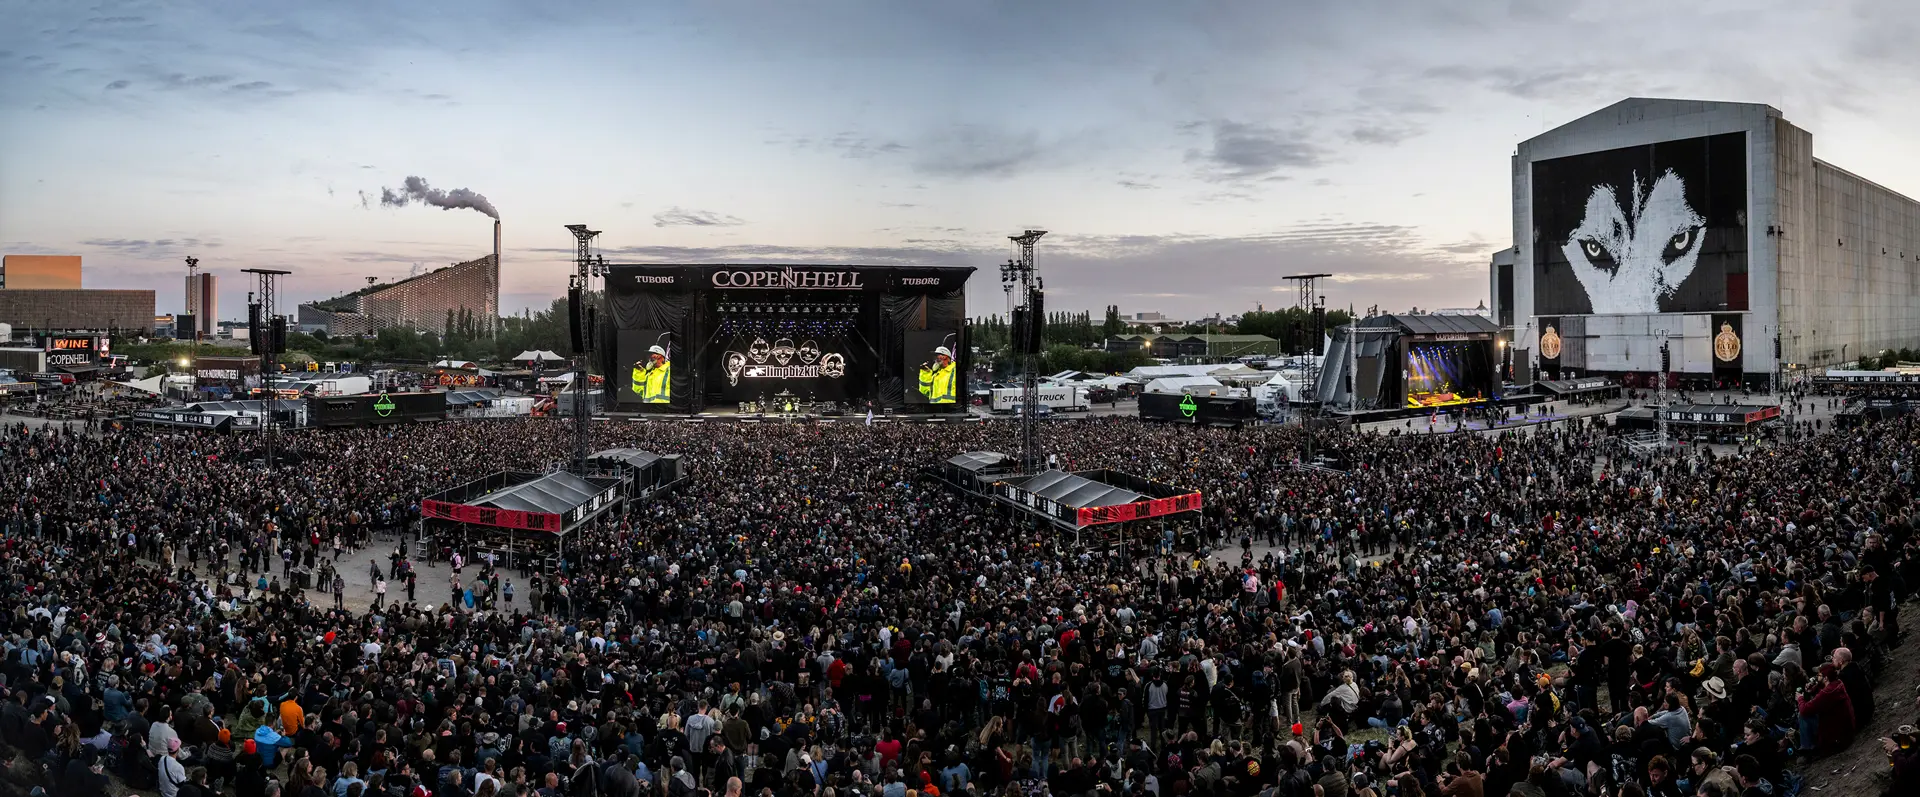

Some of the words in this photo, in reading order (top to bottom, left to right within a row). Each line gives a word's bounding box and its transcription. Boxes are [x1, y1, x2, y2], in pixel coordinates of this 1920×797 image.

[635, 275, 674, 284] TUBORG
[711, 266, 864, 289] COPENHELL
[902, 277, 940, 286] TUBORG
[54, 339, 89, 349] WINE
[46, 354, 91, 366] #COPENHELL
[1002, 395, 1025, 403] STAG
[1039, 393, 1066, 402] TRUCK
[1092, 508, 1109, 522] BAR
[1135, 502, 1151, 518] BAR
[1175, 496, 1190, 512] BAR
[435, 503, 452, 518] BAR
[480, 508, 497, 525] BAR
[527, 513, 545, 529] BAR
